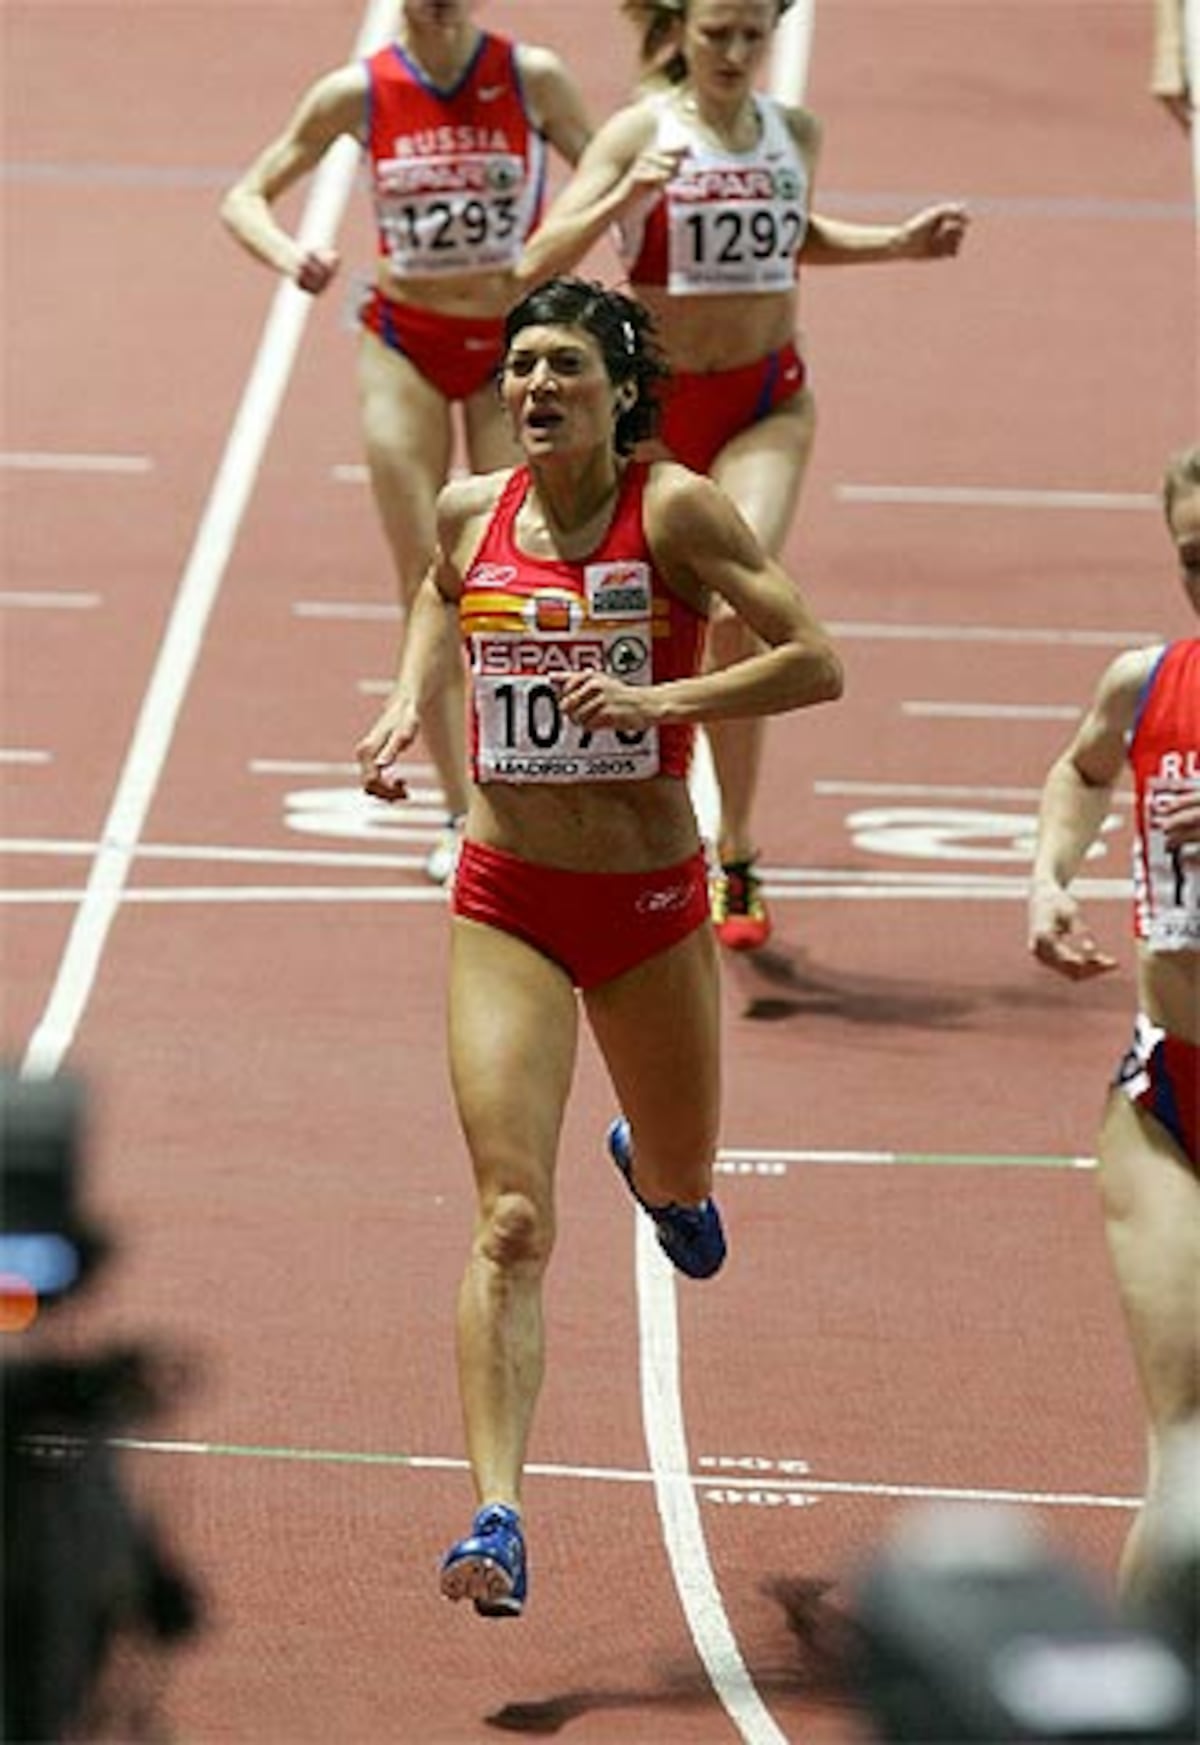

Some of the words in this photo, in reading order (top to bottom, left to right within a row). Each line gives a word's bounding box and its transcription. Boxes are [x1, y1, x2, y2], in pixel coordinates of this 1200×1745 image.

[393, 127, 508, 157] RUSSIA
[401, 198, 517, 249] 1293
[482, 643, 603, 674] SPAR
